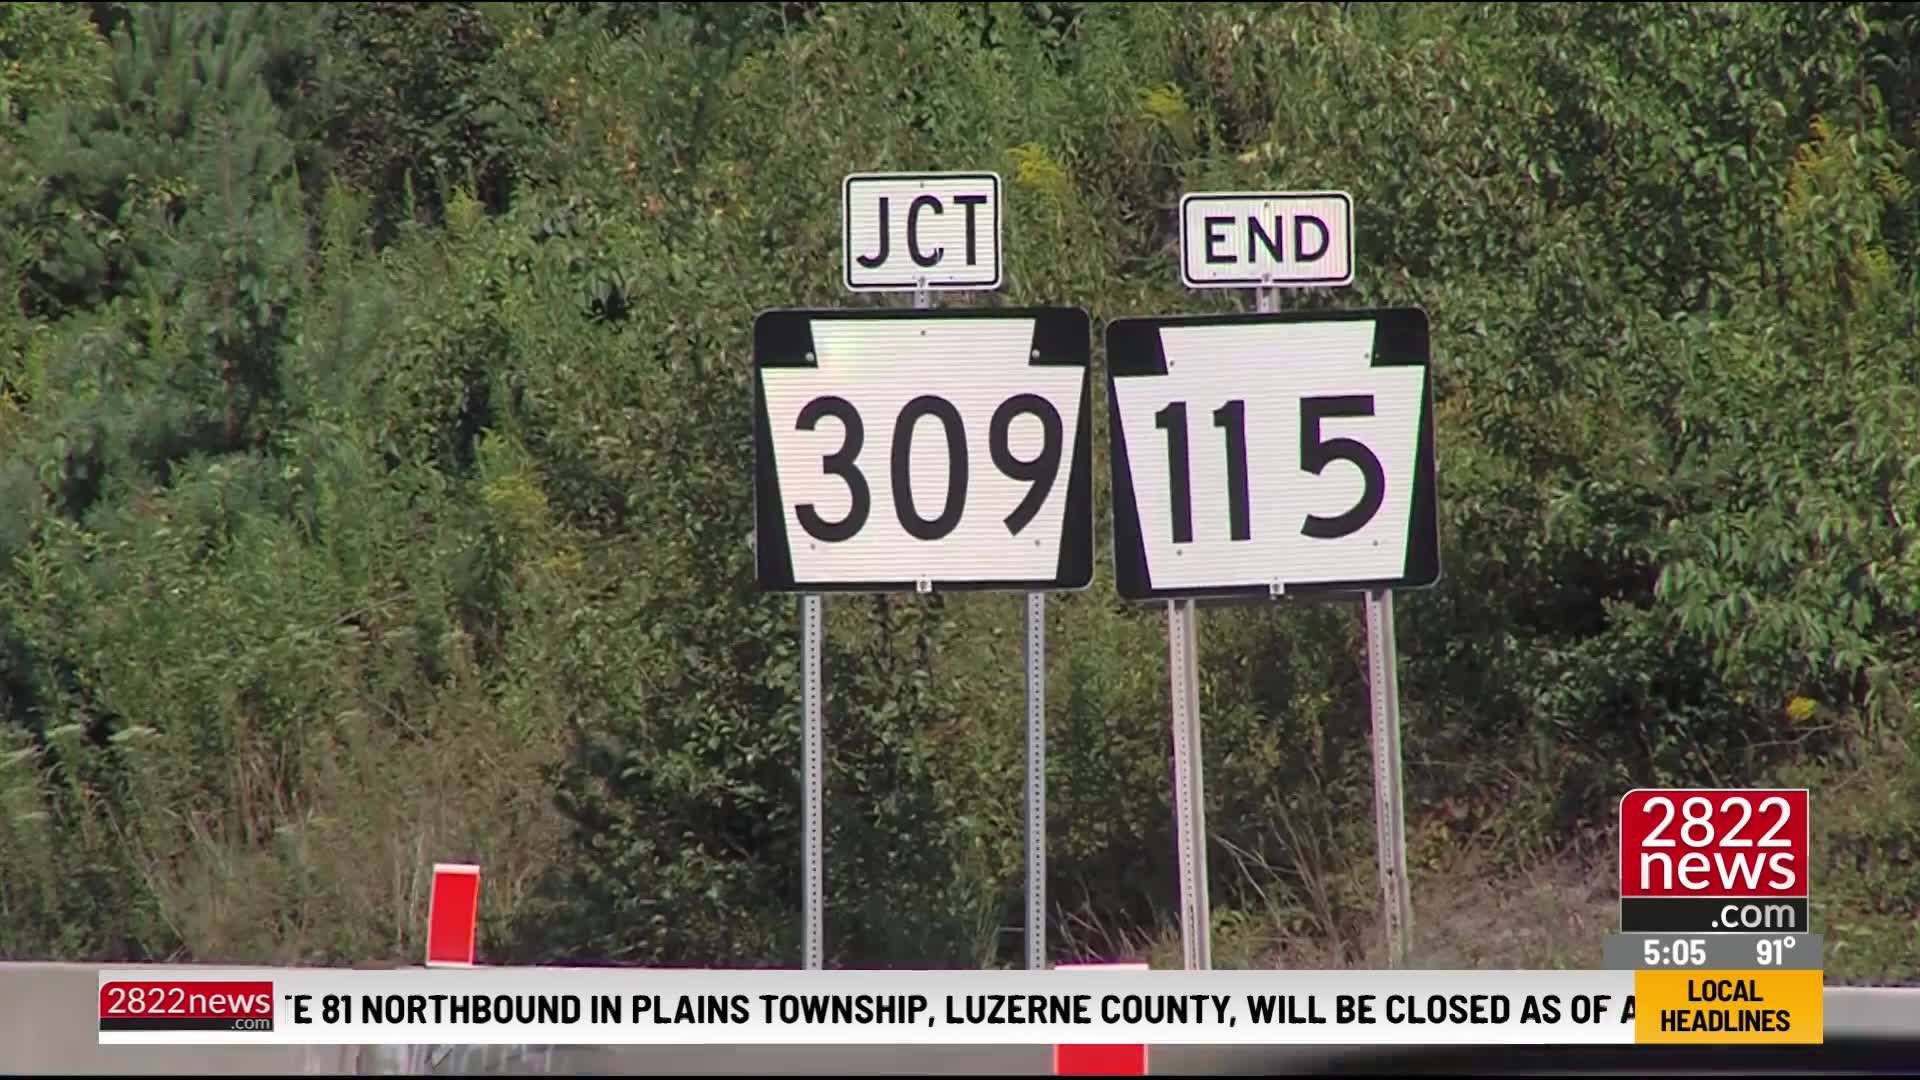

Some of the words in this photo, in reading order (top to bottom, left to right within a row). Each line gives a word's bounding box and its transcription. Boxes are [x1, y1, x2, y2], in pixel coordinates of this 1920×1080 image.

[856, 194, 988, 270] JCT
[1204, 214, 1330, 265] END
[794, 393, 1063, 543] 309
[1155, 394, 1386, 544] 115
